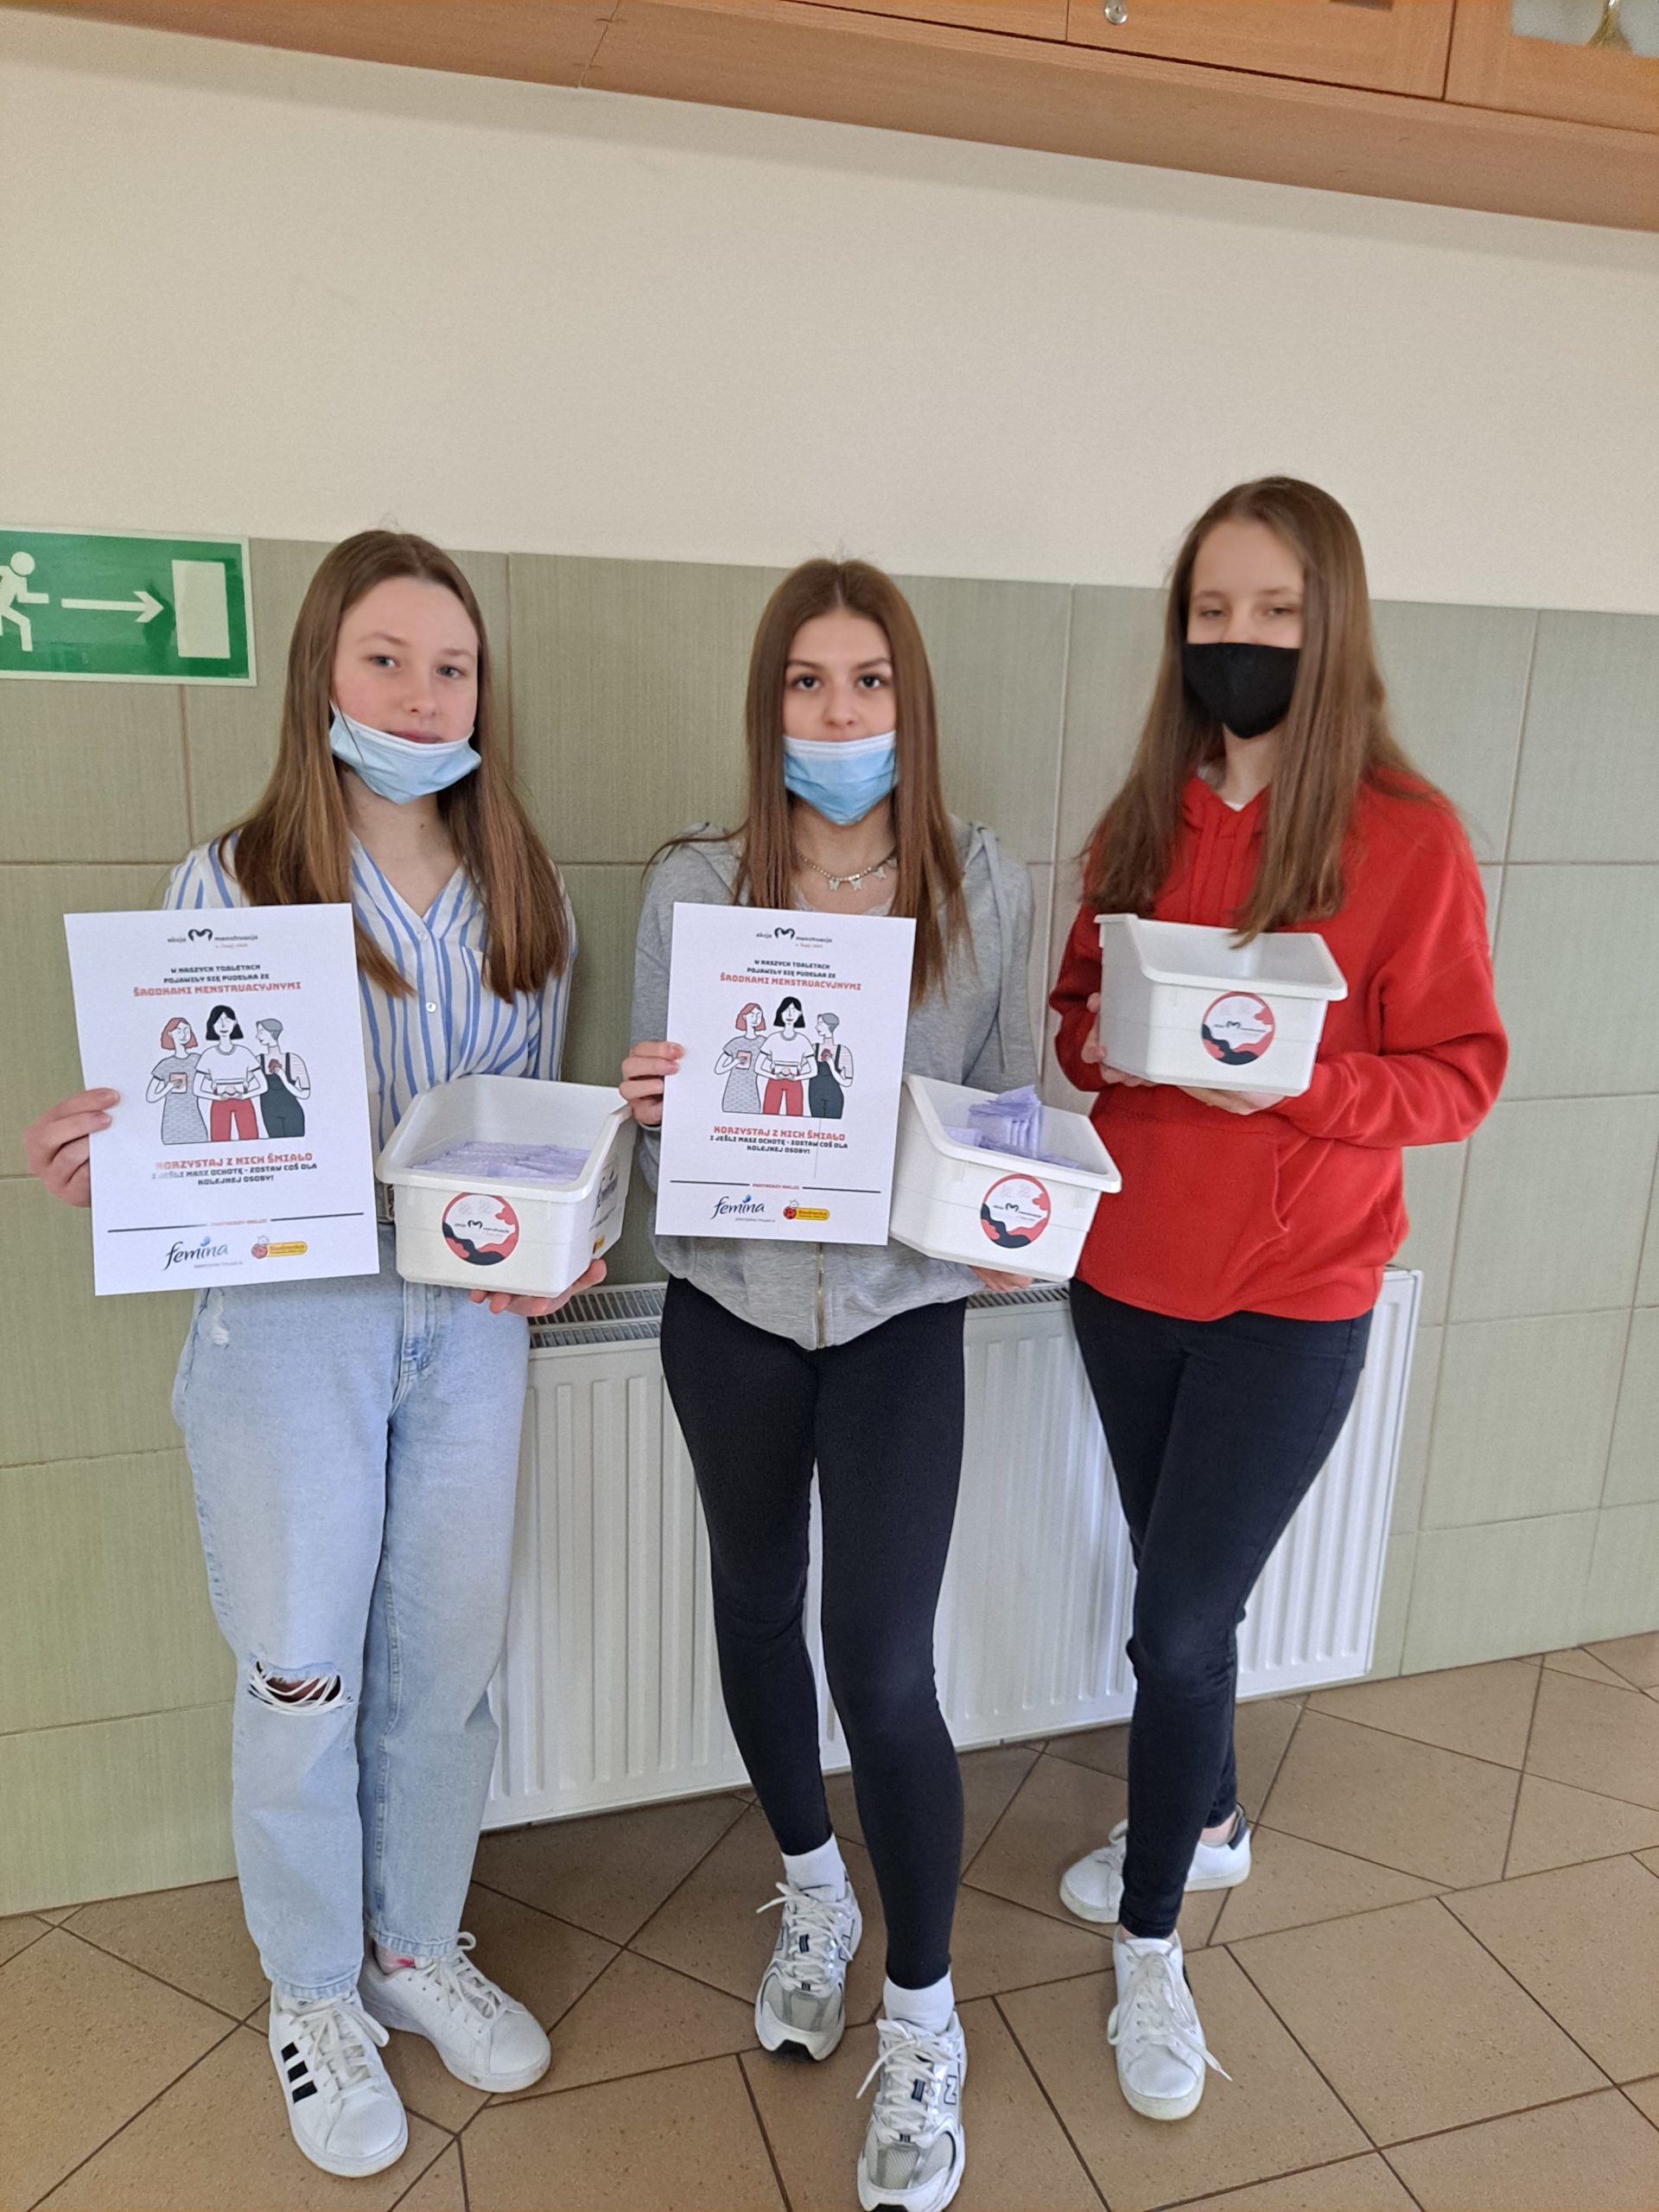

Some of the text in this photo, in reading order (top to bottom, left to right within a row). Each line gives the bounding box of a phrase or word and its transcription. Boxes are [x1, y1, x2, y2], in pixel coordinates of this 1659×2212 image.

[720, 972, 861, 991] ŚRODKAMI MENSTRUACYJNYMI
[133, 982, 302, 996] ŚRODKAMI MENSTRUACYJNYMI
[714, 1126, 771, 1136] KORZYSTAJ
[780, 1129, 805, 1139] NICH
[807, 1128, 846, 1141] ŚMIAŁO
[236, 1155, 264, 1166] NICH
[267, 1153, 313, 1164] ŚMIAŁO
[211, 1167, 244, 1176] OCHOTĘ
[197, 1177, 242, 1185] KOLEJNEJ
[710, 1194, 765, 1219] femina
[162, 1236, 229, 1270] femina
